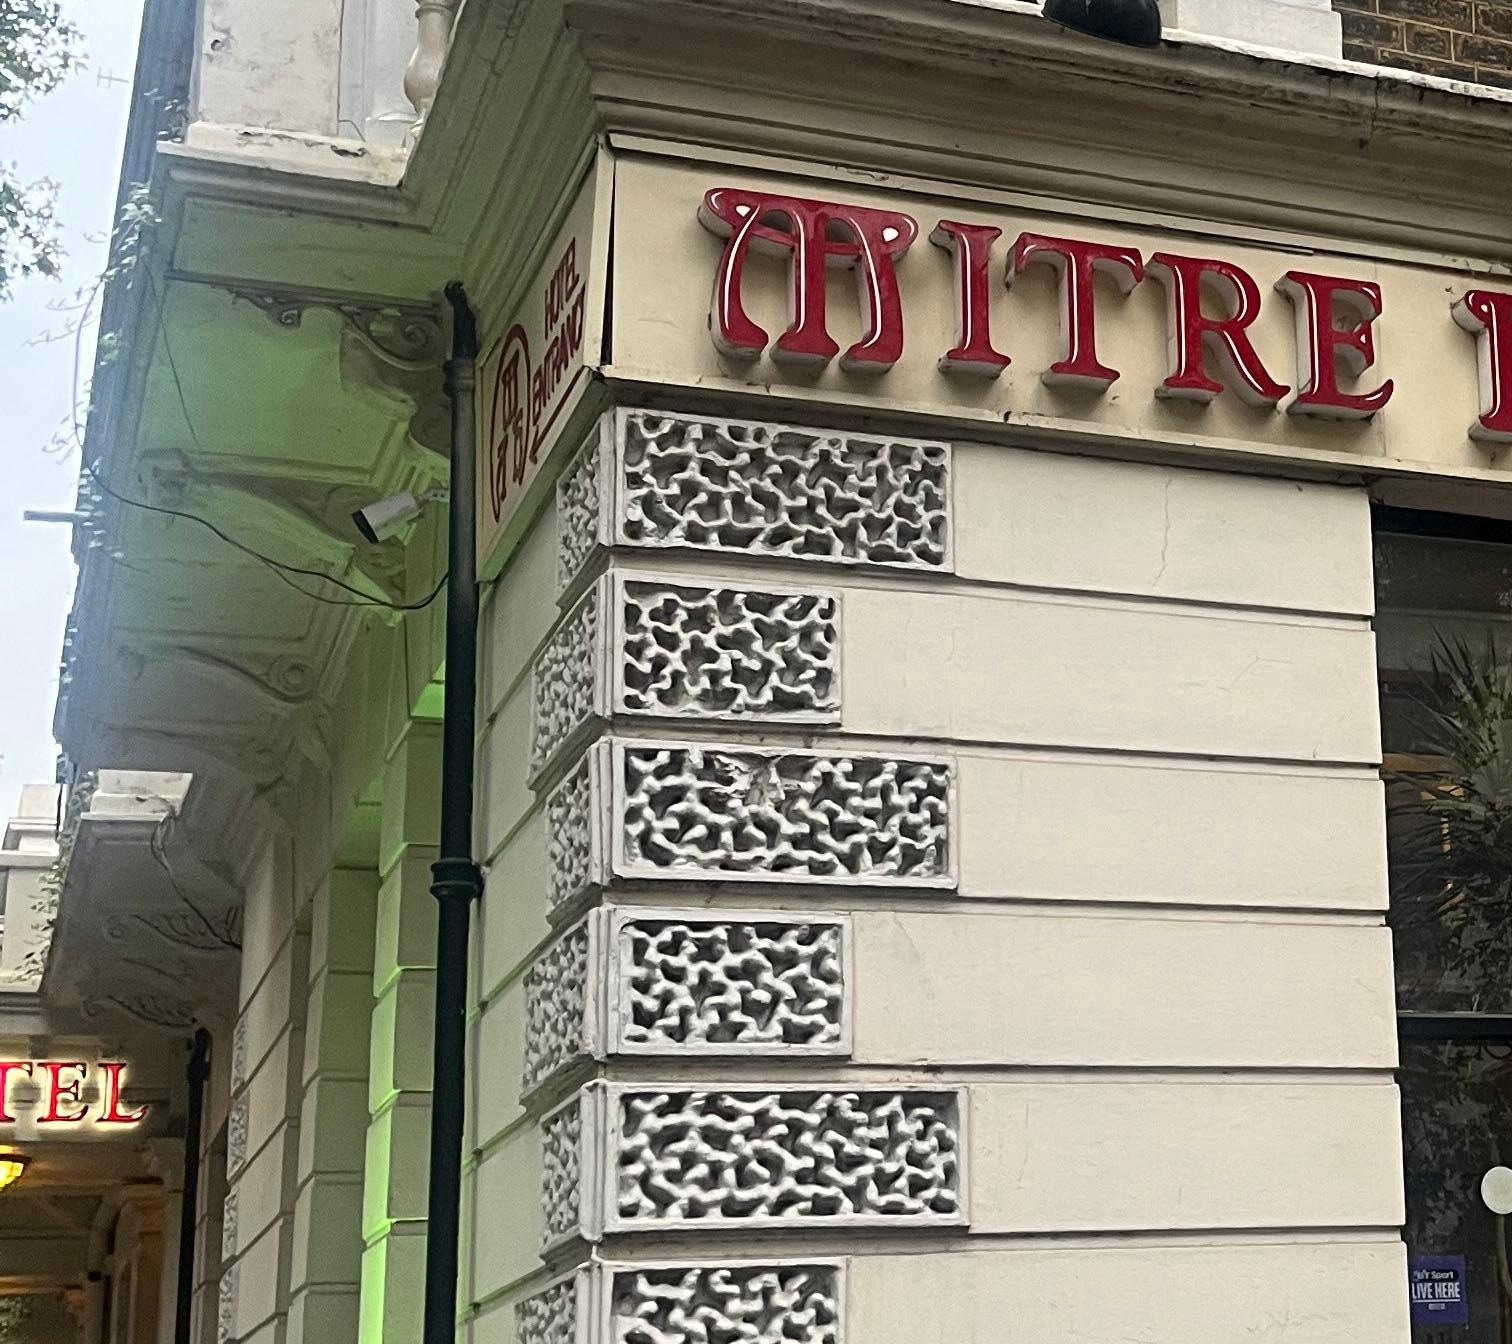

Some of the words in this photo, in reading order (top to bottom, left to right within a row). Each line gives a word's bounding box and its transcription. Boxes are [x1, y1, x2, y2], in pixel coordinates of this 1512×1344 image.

[545, 237, 580, 340] HOTEL
[703, 187, 1394, 411] MITRE
[1412, 1282, 1433, 1299] LIVE
[1435, 1281, 1460, 1299] HERE
